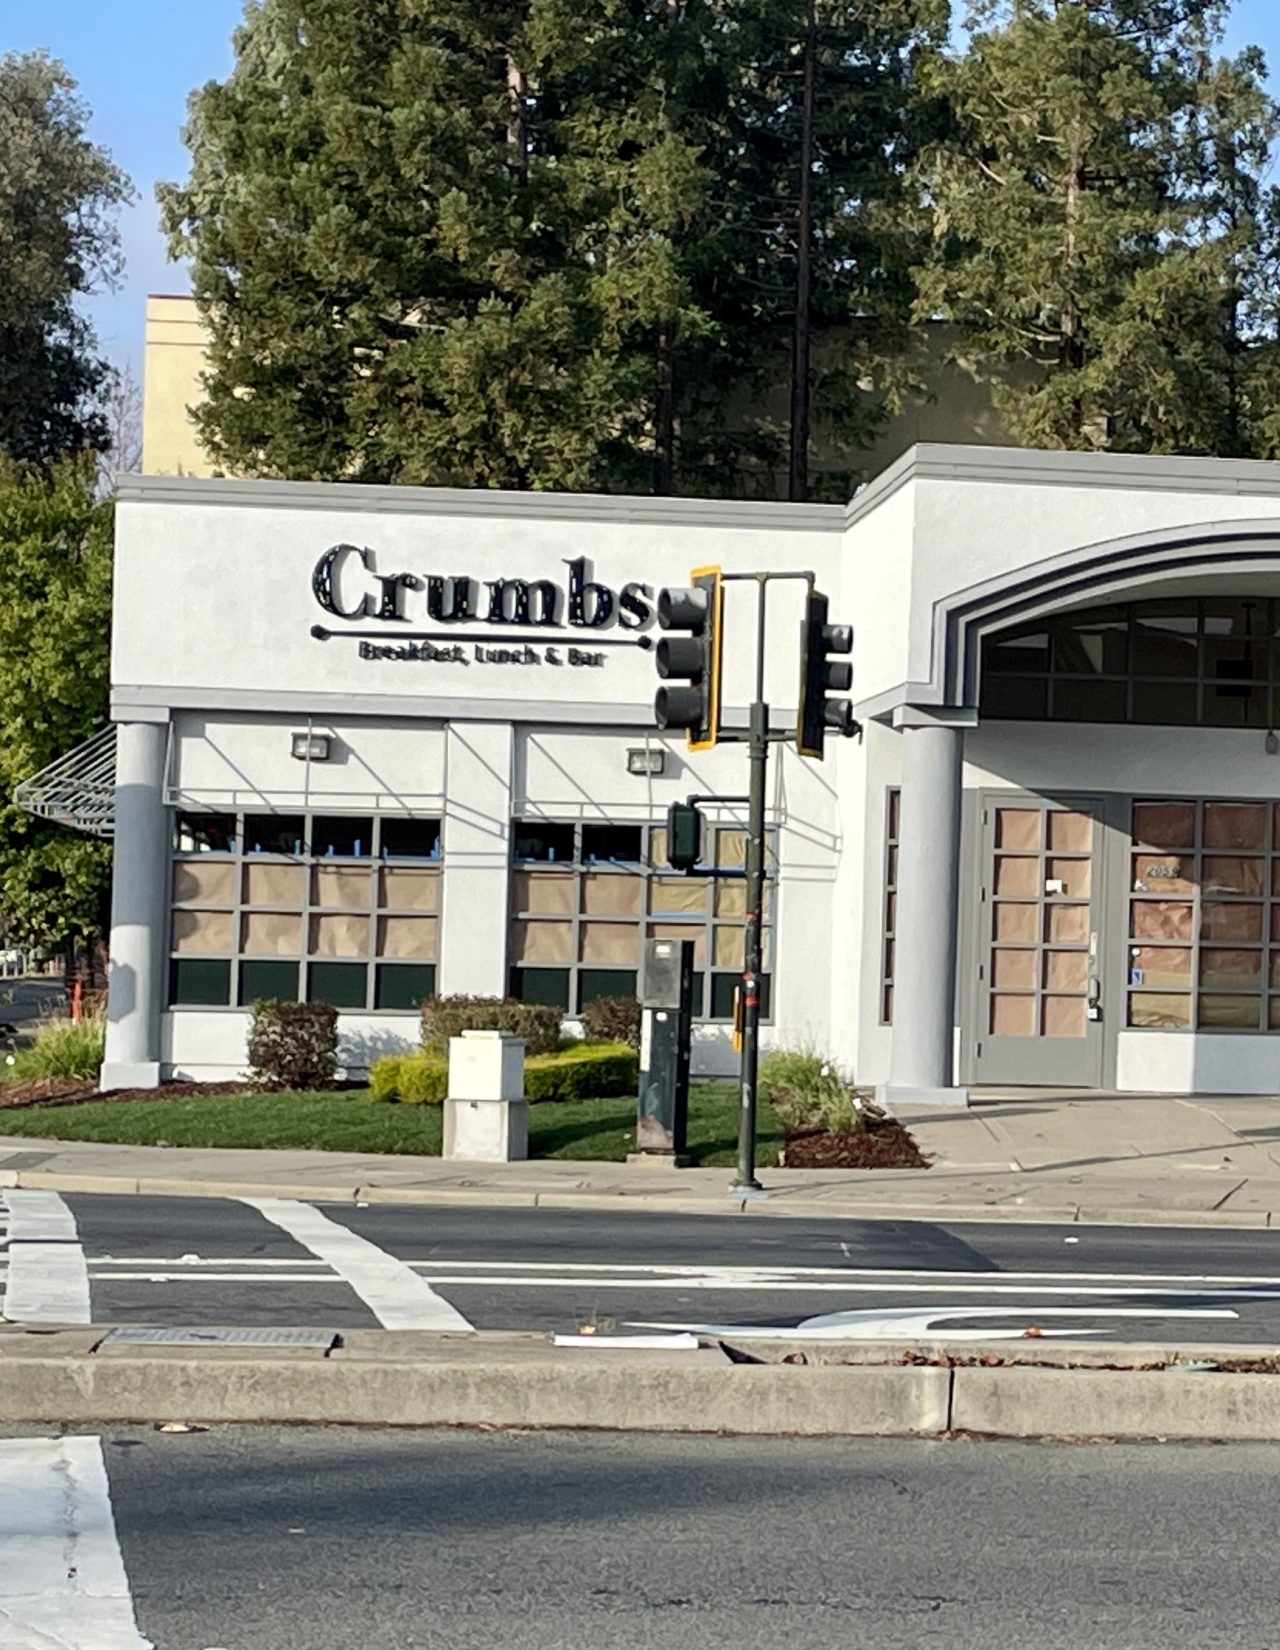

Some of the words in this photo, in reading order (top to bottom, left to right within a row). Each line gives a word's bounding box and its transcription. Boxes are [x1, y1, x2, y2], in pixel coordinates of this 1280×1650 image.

[312, 543, 657, 632] Crumbs
[359, 640, 470, 666] Breakfast,
[475, 643, 541, 665] Lunch
[544, 646, 563, 666] &
[567, 646, 608, 668] Bar
